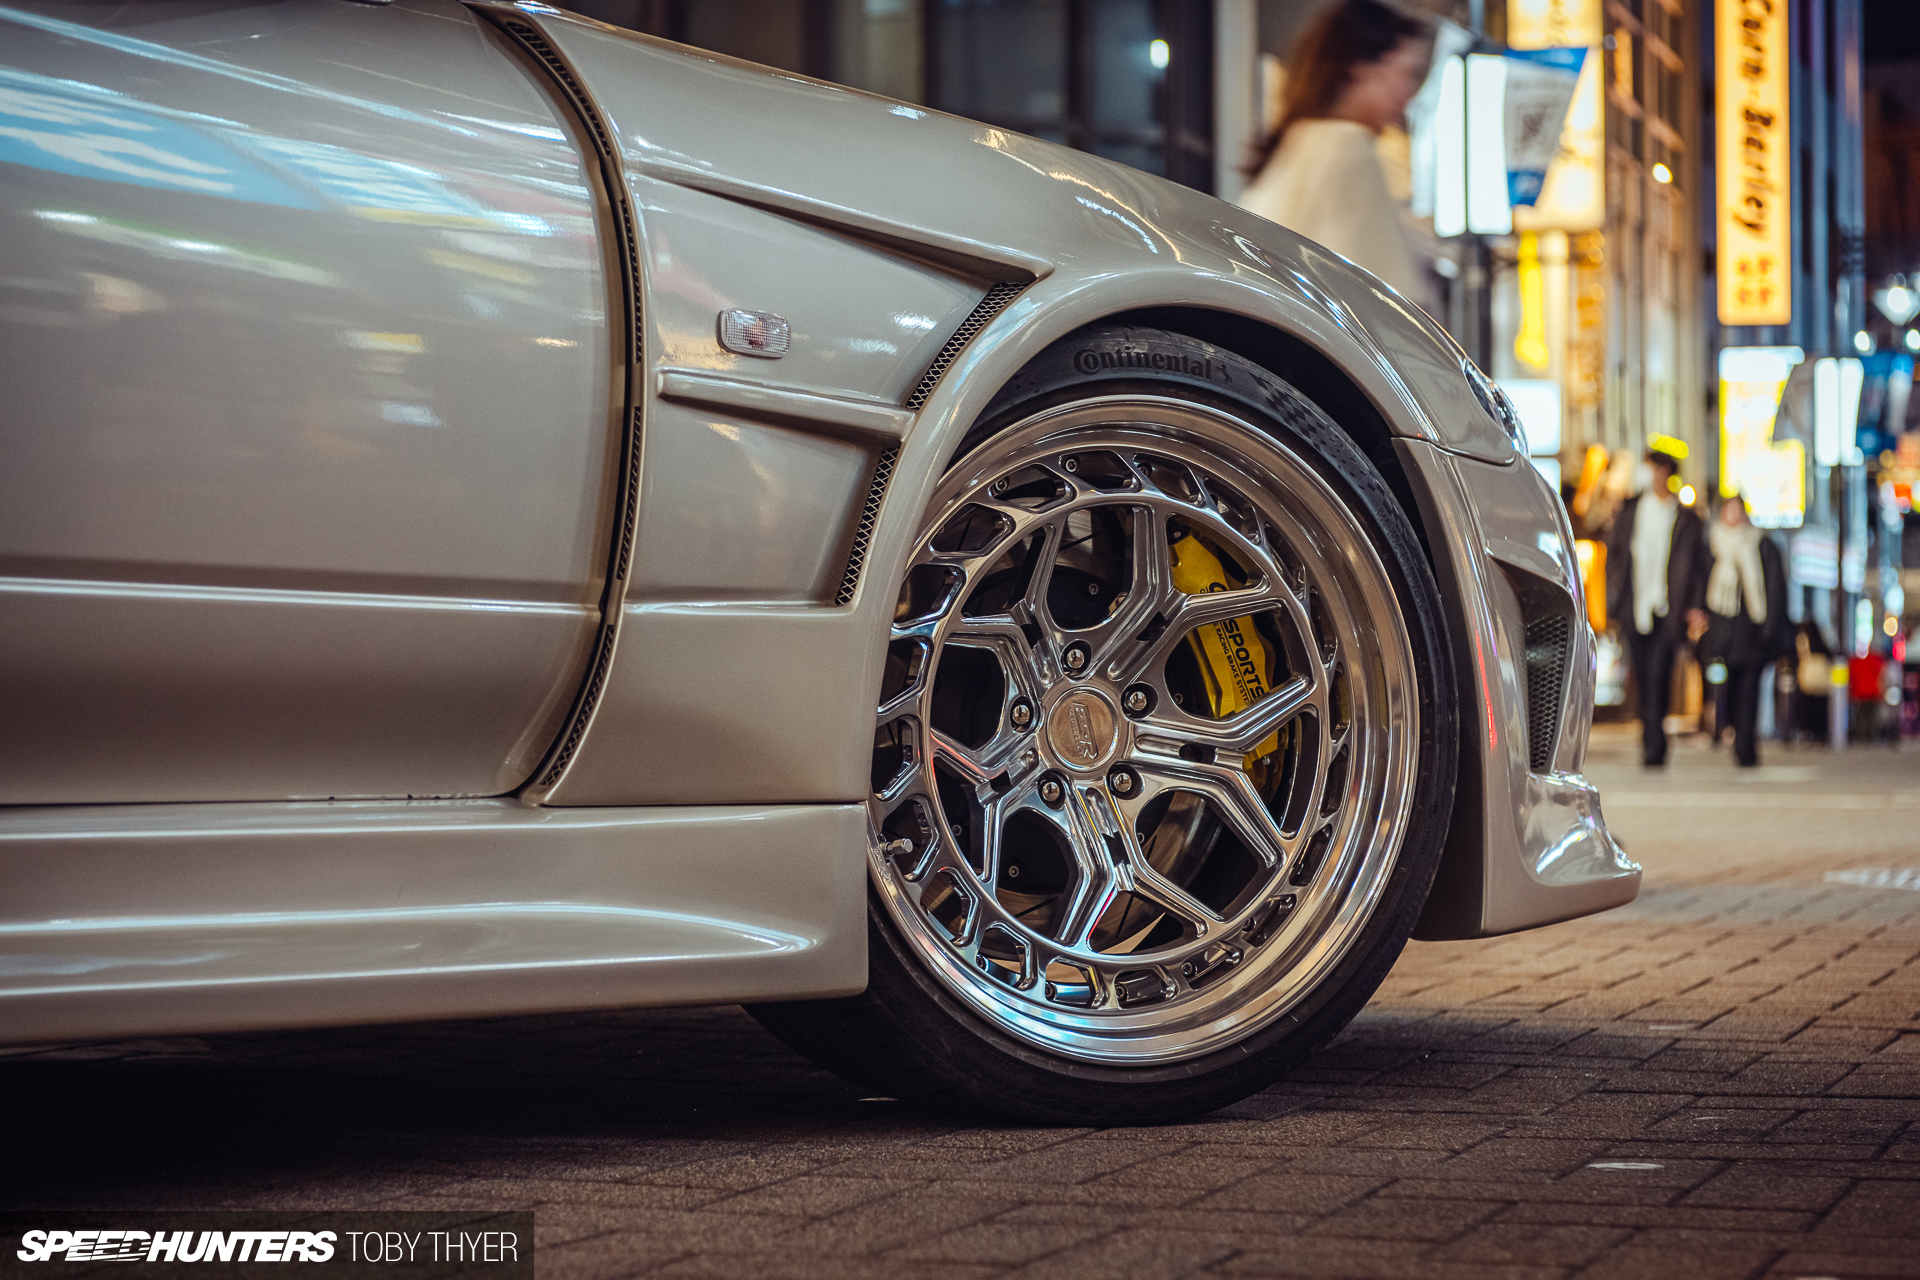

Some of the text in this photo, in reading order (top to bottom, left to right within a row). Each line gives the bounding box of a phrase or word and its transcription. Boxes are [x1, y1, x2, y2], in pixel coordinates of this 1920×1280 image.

[1074, 345, 1213, 380] Continental
[1216, 628, 1249, 703] RACING BRAKE SYSTE
[1223, 618, 1264, 698] SPORTS
